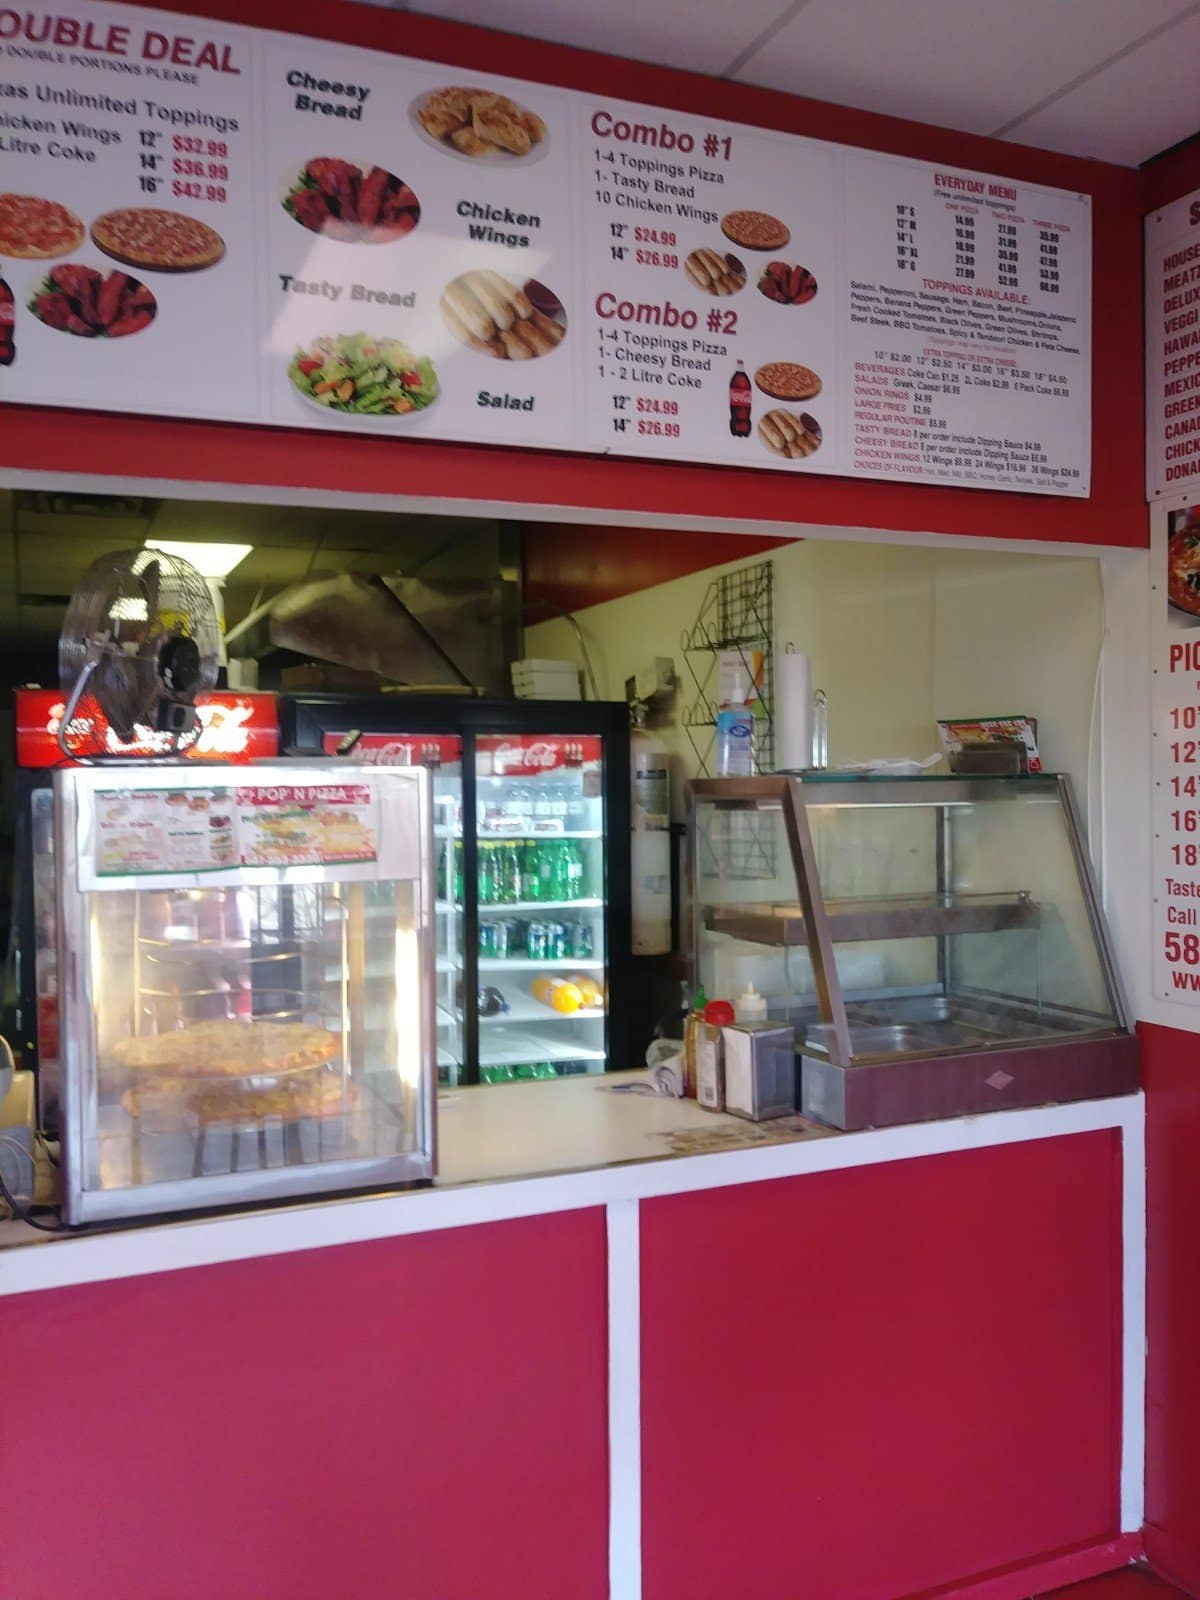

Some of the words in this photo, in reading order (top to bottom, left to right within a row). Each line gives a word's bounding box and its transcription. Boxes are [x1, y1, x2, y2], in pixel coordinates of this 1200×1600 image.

[0, 8, 130, 56] OUBLE
[142, 30, 241, 75] DEAL
[146, 66, 199, 85] PLEASE
[287, 70, 371, 101] Cheesy
[35, 84, 137, 116] Unlimited
[145, 101, 239, 134] Toppings
[295, 93, 363, 121] Bread
[62, 120, 121, 145] Wings
[591, 111, 695, 153] Combo
[703, 132, 733, 161] #1
[48, 142, 97, 163] Coke
[172, 134, 228, 158] $32.99
[619, 153, 685, 178] Toppings
[689, 166, 725, 184] Pizza
[612, 172, 650, 193] Tasty
[654, 180, 696, 198] Bread
[934, 173, 985, 194] EVERYDAY
[988, 184, 1017, 201] MENU
[456, 201, 541, 229] Chicken
[595, 191, 611, 204] 10
[615, 194, 673, 215] Chicken
[676, 203, 719, 225] Wings
[468, 224, 529, 248] Wings
[634, 228, 676, 246] $24.99
[636, 250, 679, 269] $26.99
[279, 274, 344, 301] Tasty
[350, 285, 416, 309] Bread
[921, 278, 973, 296] TOPPINGS
[595, 292, 698, 330] Combo
[707, 308, 738, 335] #2
[623, 331, 688, 352] Toppings
[692, 339, 727, 356] Pizza
[615, 347, 667, 367] Cheesy
[671, 355, 711, 371] Bread
[619, 367, 628, 381] 2
[632, 369, 663, 386] Litre
[667, 372, 702, 389] Coke
[476, 390, 535, 412] Salad
[636, 397, 678, 415] $24.99
[638, 421, 680, 438] $26.99
[308, 786, 347, 801] PIZZA
[1168, 906, 1197, 926] Call
